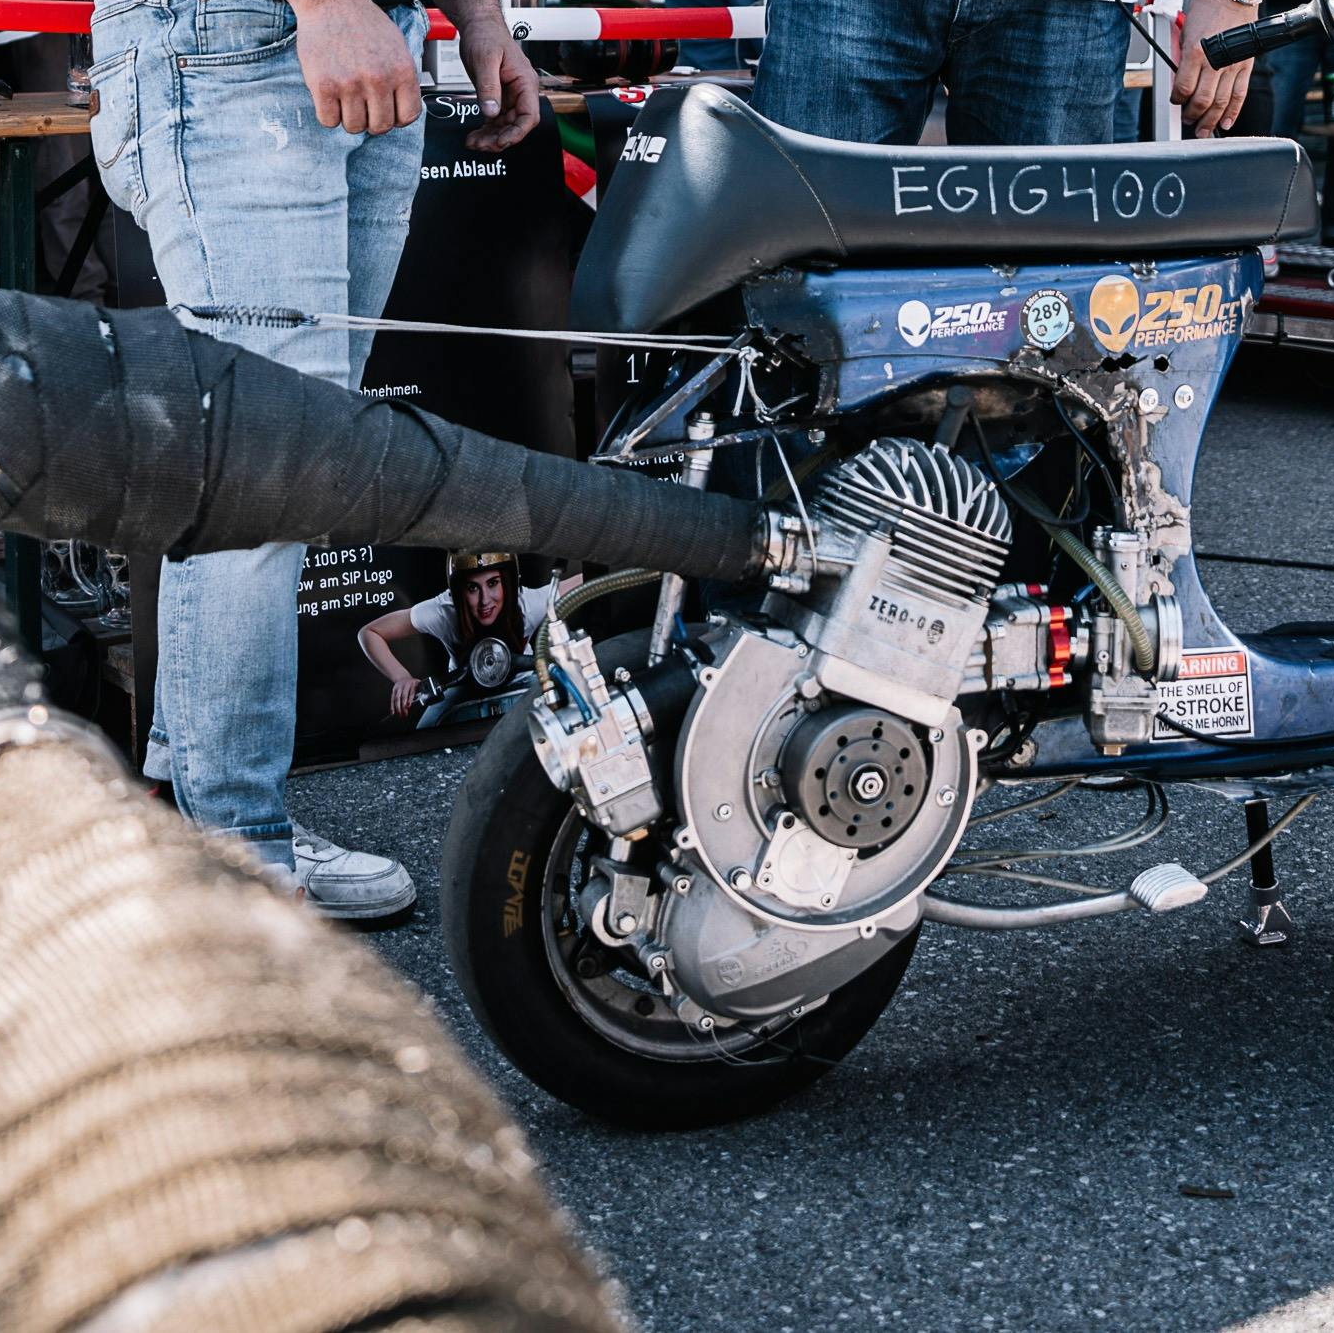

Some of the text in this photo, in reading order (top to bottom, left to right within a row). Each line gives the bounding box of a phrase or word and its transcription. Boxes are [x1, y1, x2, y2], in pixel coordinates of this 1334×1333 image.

[421, 159, 507, 179] sen Ablauf:
[930, 301, 1008, 330] 250cc
[1032, 301, 1061, 323] 289
[1138, 283, 1242, 332] 250cc
[930, 320, 1005, 339] PERFORMANCE
[1134, 319, 1238, 348] PERFORMANCE
[315, 551, 338, 567] 100
[341, 548, 357, 563] PS
[297, 568, 393, 592] ow am SIP Logo
[297, 589, 395, 616] ung am SIP Logo
[1179, 655, 1238, 676] ARNING
[1160, 681, 1243, 698] THE SMELL OF
[1158, 696, 1244, 716] 2-STROKE
[1158, 715, 1245, 732] MES ME HORNY
